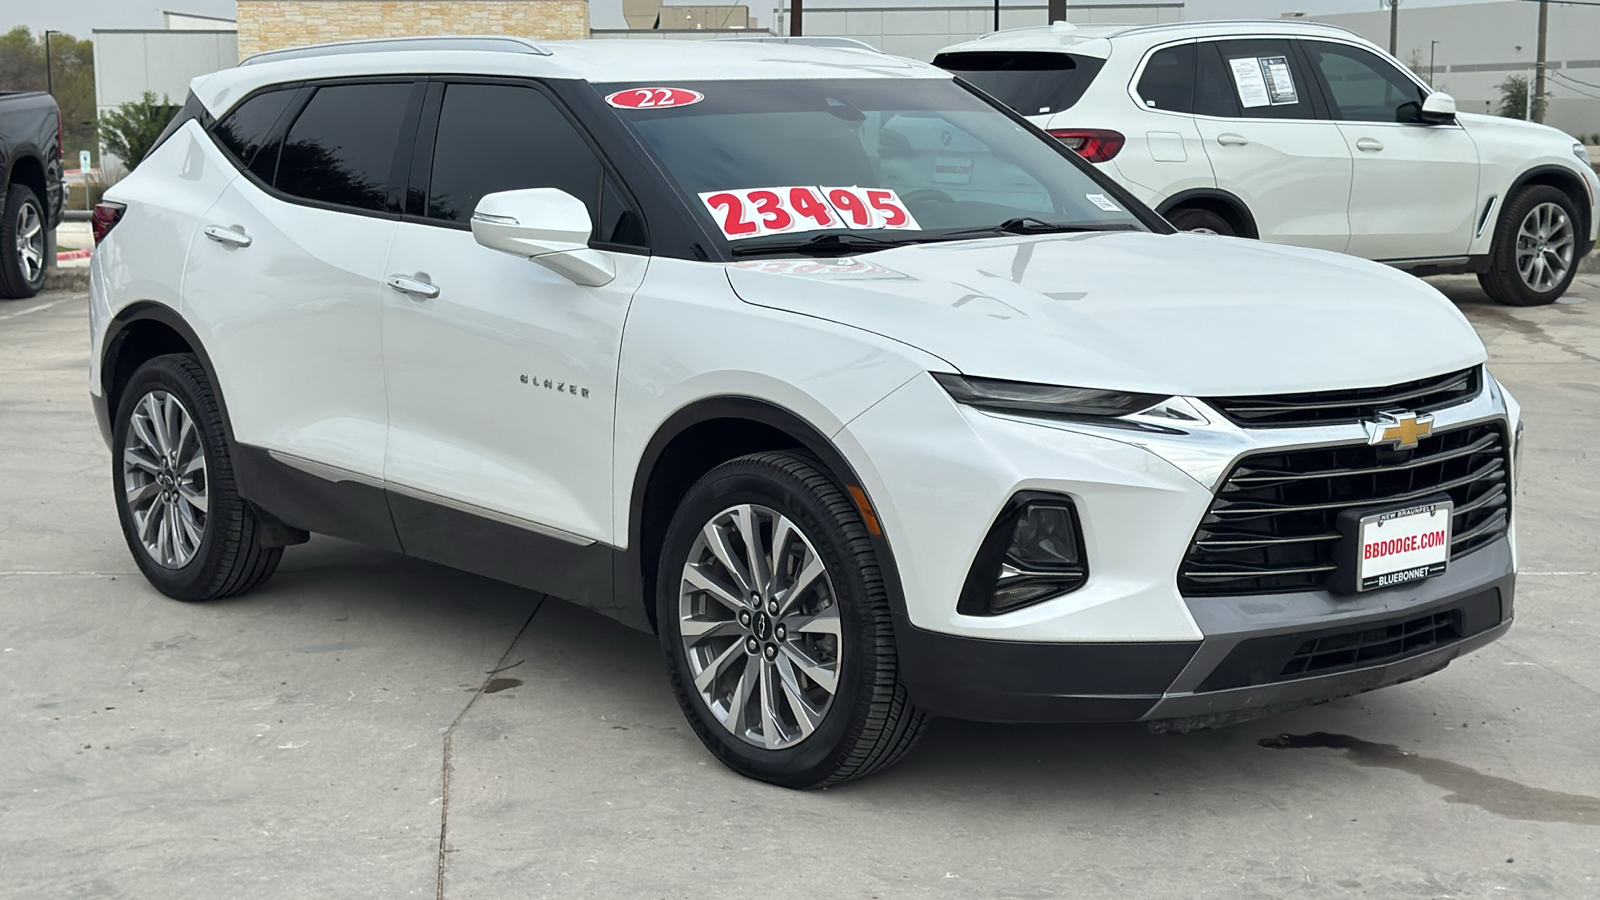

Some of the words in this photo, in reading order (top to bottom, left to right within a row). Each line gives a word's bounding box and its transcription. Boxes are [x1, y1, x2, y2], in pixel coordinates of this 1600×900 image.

[635, 89, 675, 108] 22
[707, 187, 910, 236] 23495
[519, 373, 590, 399] BLAZER
[1381, 512, 1397, 521] NEW
[1397, 504, 1435, 518] BRAUNFELS
[1364, 530, 1445, 560] BBDODGE.COM
[1378, 566, 1430, 586] BLUEBONNET
